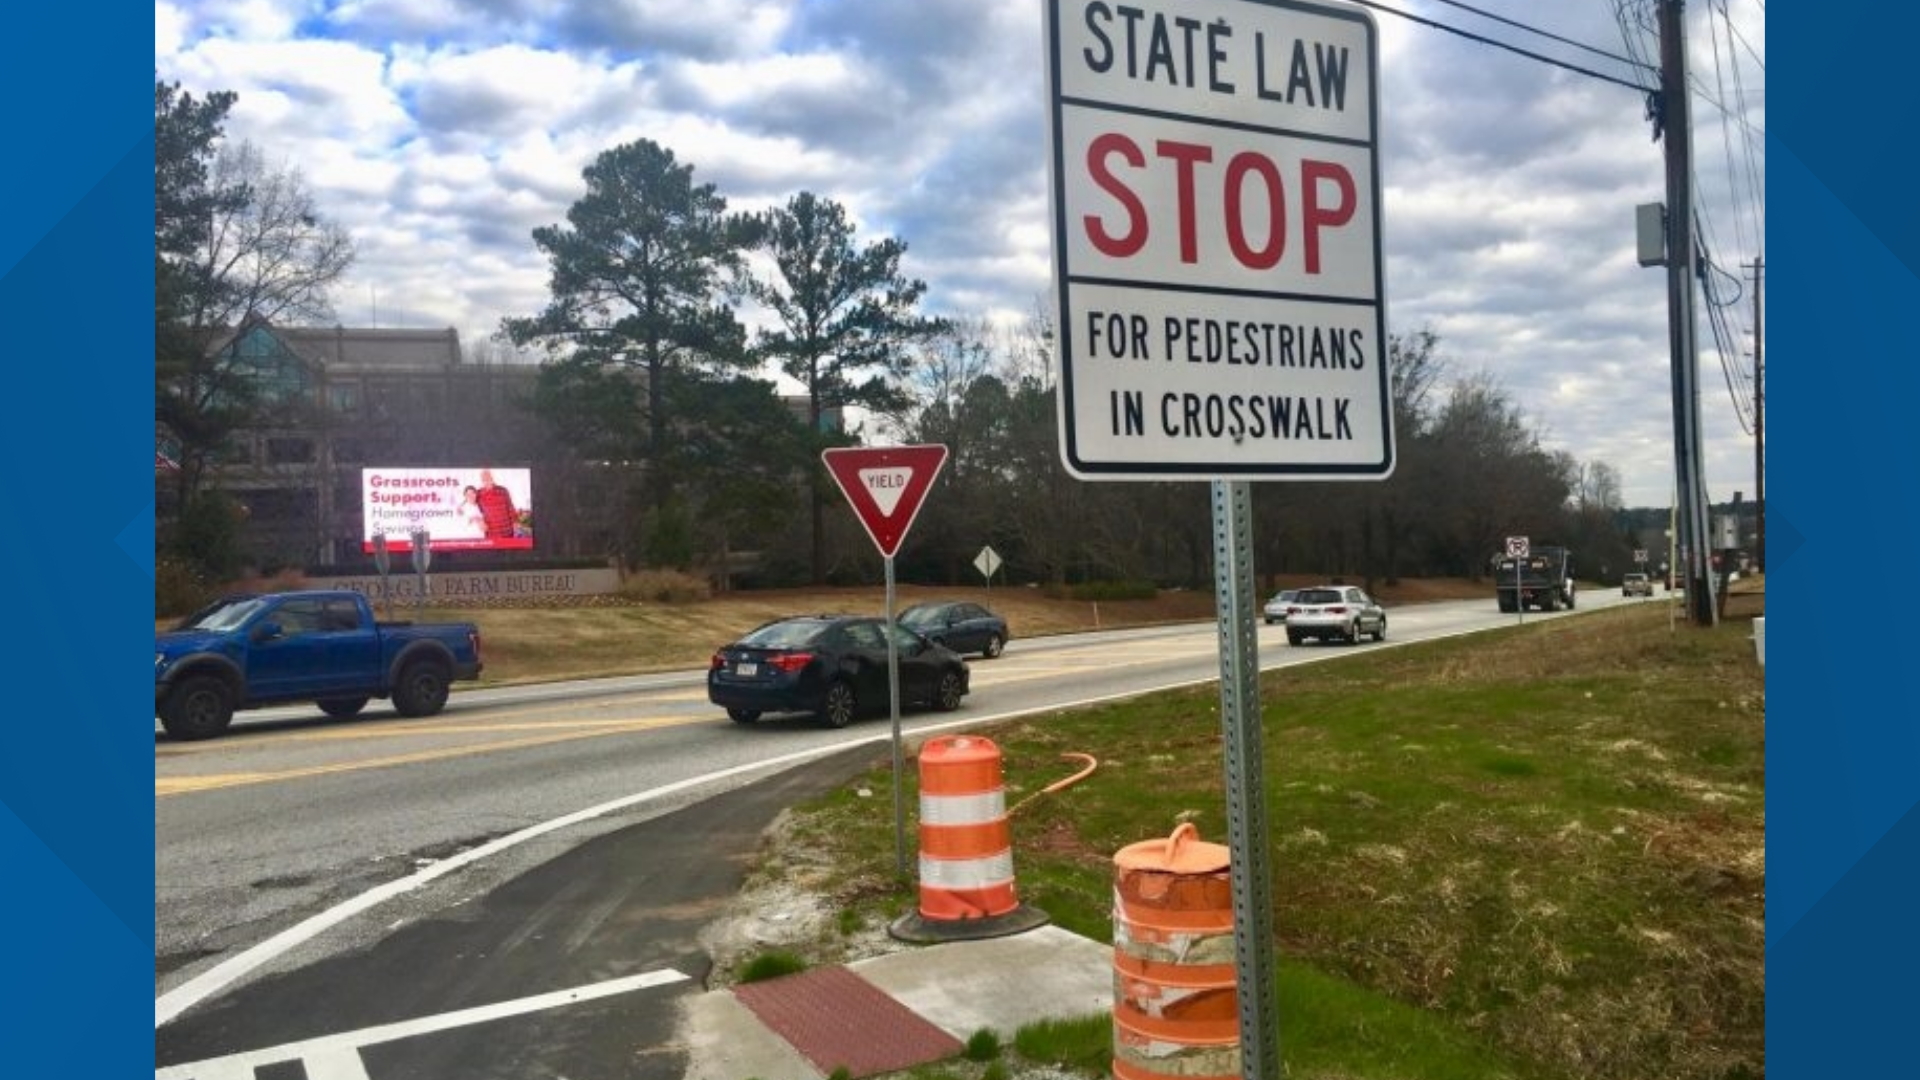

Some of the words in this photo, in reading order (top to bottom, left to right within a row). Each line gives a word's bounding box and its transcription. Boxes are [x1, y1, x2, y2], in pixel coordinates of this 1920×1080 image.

[1083, 1, 1235, 94] STATE
[1255, 32, 1348, 111] LAW
[1083, 133, 1357, 274] STOP
[1088, 311, 1149, 360] FOR
[1165, 317, 1364, 370] PEDESTRIANS
[1111, 390, 1144, 436] IN
[1161, 393, 1352, 440] CROSSWALK
[370, 475, 460, 487] Grassroots
[868, 474, 904, 488] YIELD
[371, 491, 441, 506] Support.
[373, 507, 453, 521] Homegrown
[445, 577, 500, 595] FARM
[507, 574, 575, 592] BUREAU
